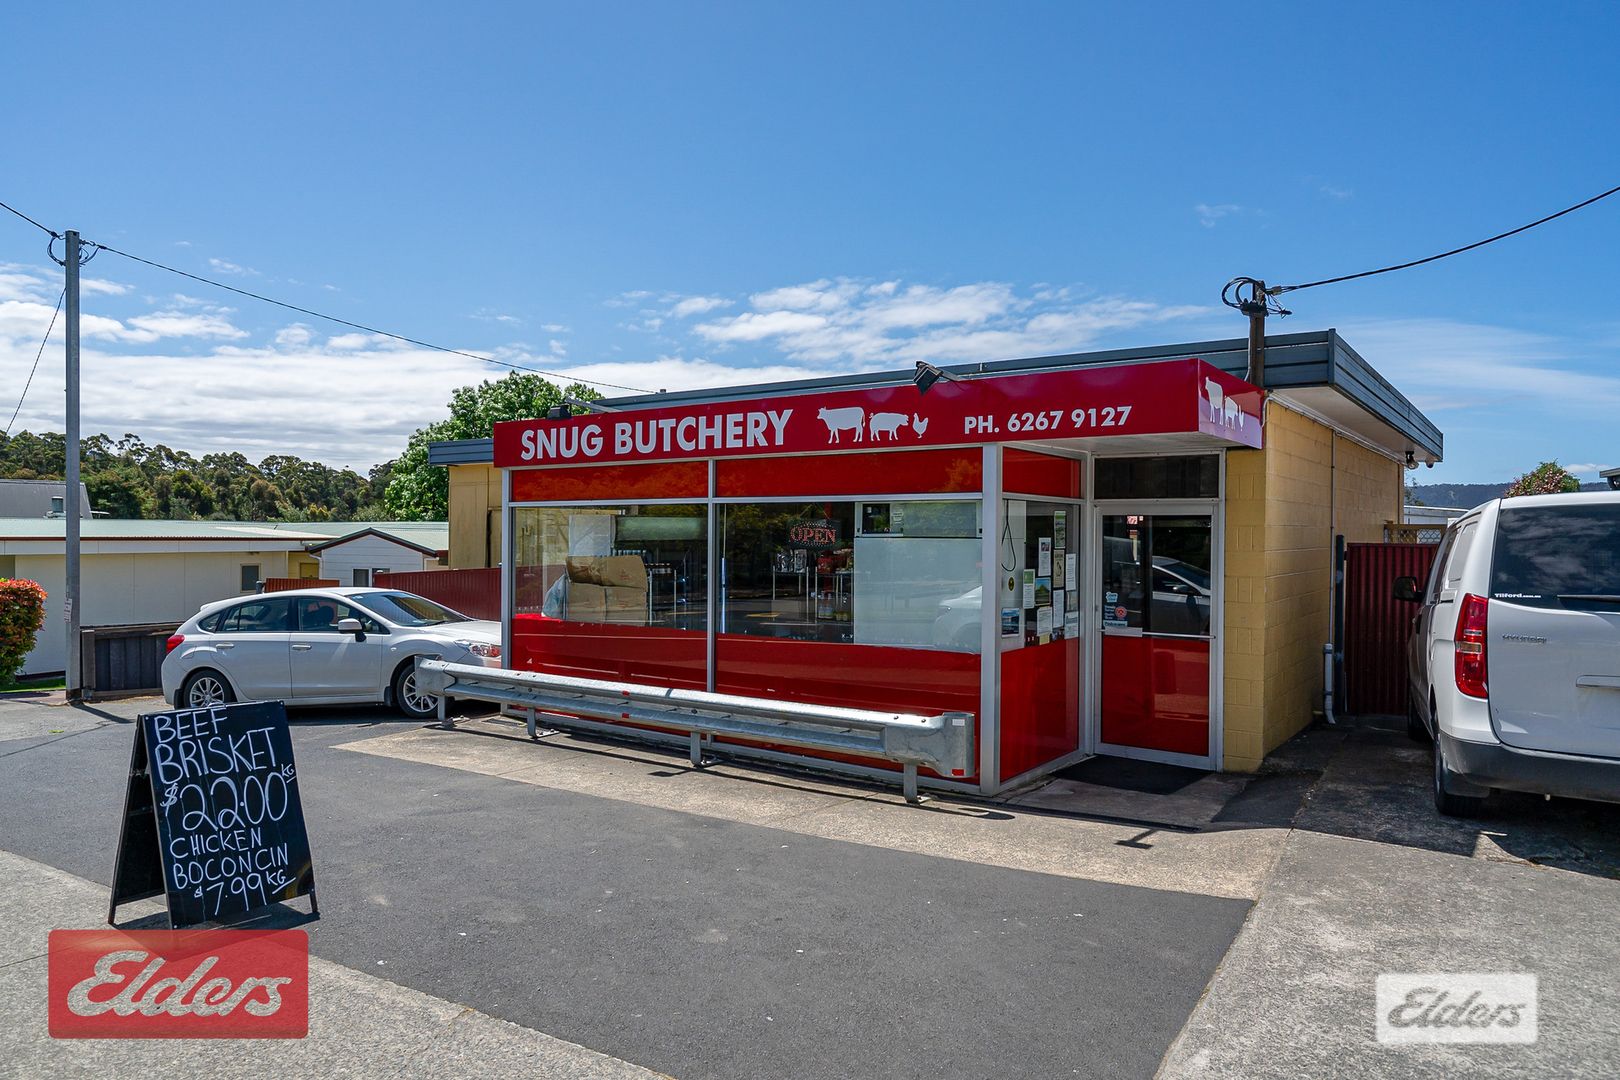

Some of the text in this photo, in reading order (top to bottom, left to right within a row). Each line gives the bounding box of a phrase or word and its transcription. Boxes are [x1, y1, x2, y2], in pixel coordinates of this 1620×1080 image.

[520, 408, 794, 461] SNUG BUTCHERY
[963, 405, 1132, 435] PH. 6267 9127
[790, 526, 836, 545] OPEN
[154, 707, 228, 744] BEEF
[154, 726, 276, 784] BRISKET
[170, 826, 262, 859] CHICKEN
[173, 842, 289, 890] BOCONCIN
